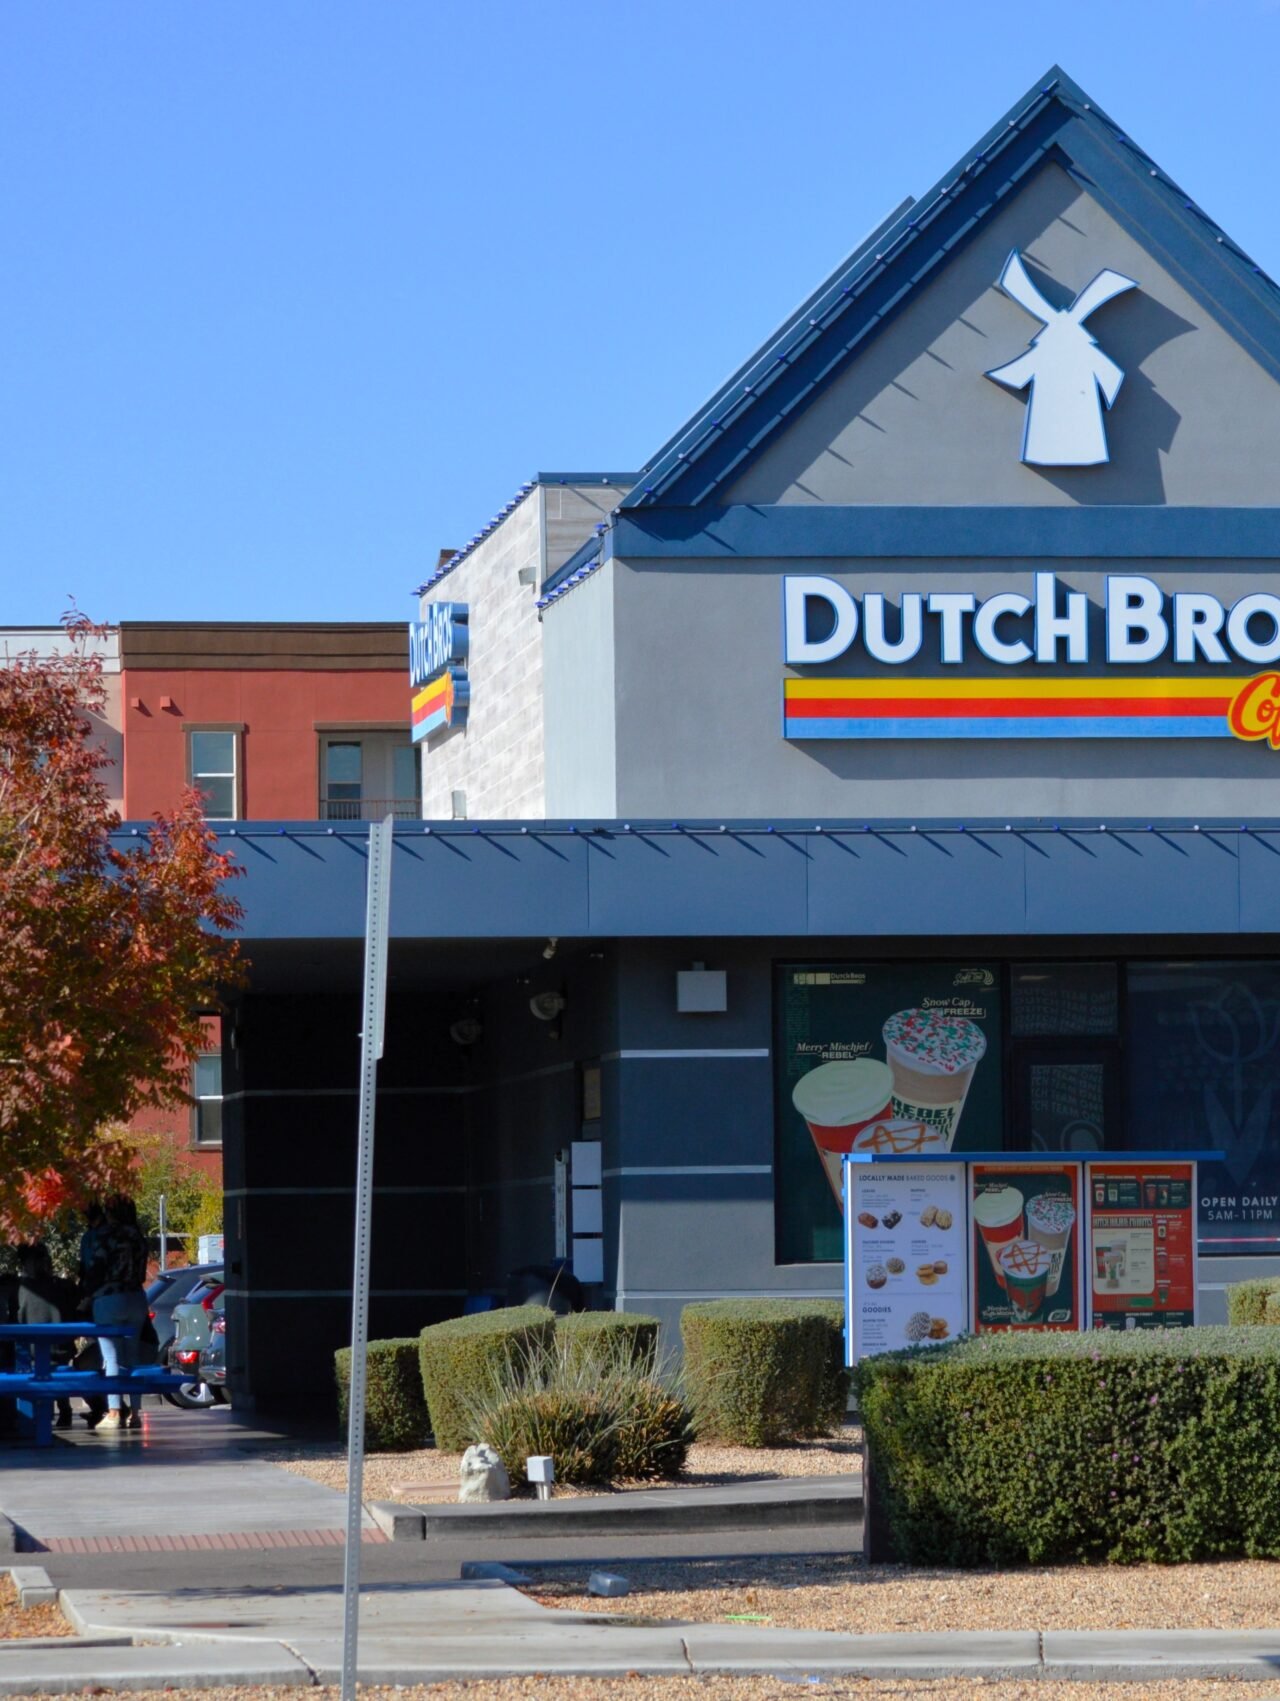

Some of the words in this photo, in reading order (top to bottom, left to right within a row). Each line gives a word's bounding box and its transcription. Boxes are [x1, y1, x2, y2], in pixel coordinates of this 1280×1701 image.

[783, 571, 1088, 665] DUTCH
[921, 997, 947, 1008] Snow
[951, 997, 972, 1008] Cap
[943, 1007, 984, 1016] FREEZE
[796, 1041, 824, 1053] Merry
[829, 1041, 870, 1053] Mischief
[821, 1051, 854, 1059] REBEL
[1201, 1197, 1236, 1208] OPEN
[1242, 1196, 1278, 1207] DAILY
[1208, 1209, 1273, 1221] 5AM-11PM
